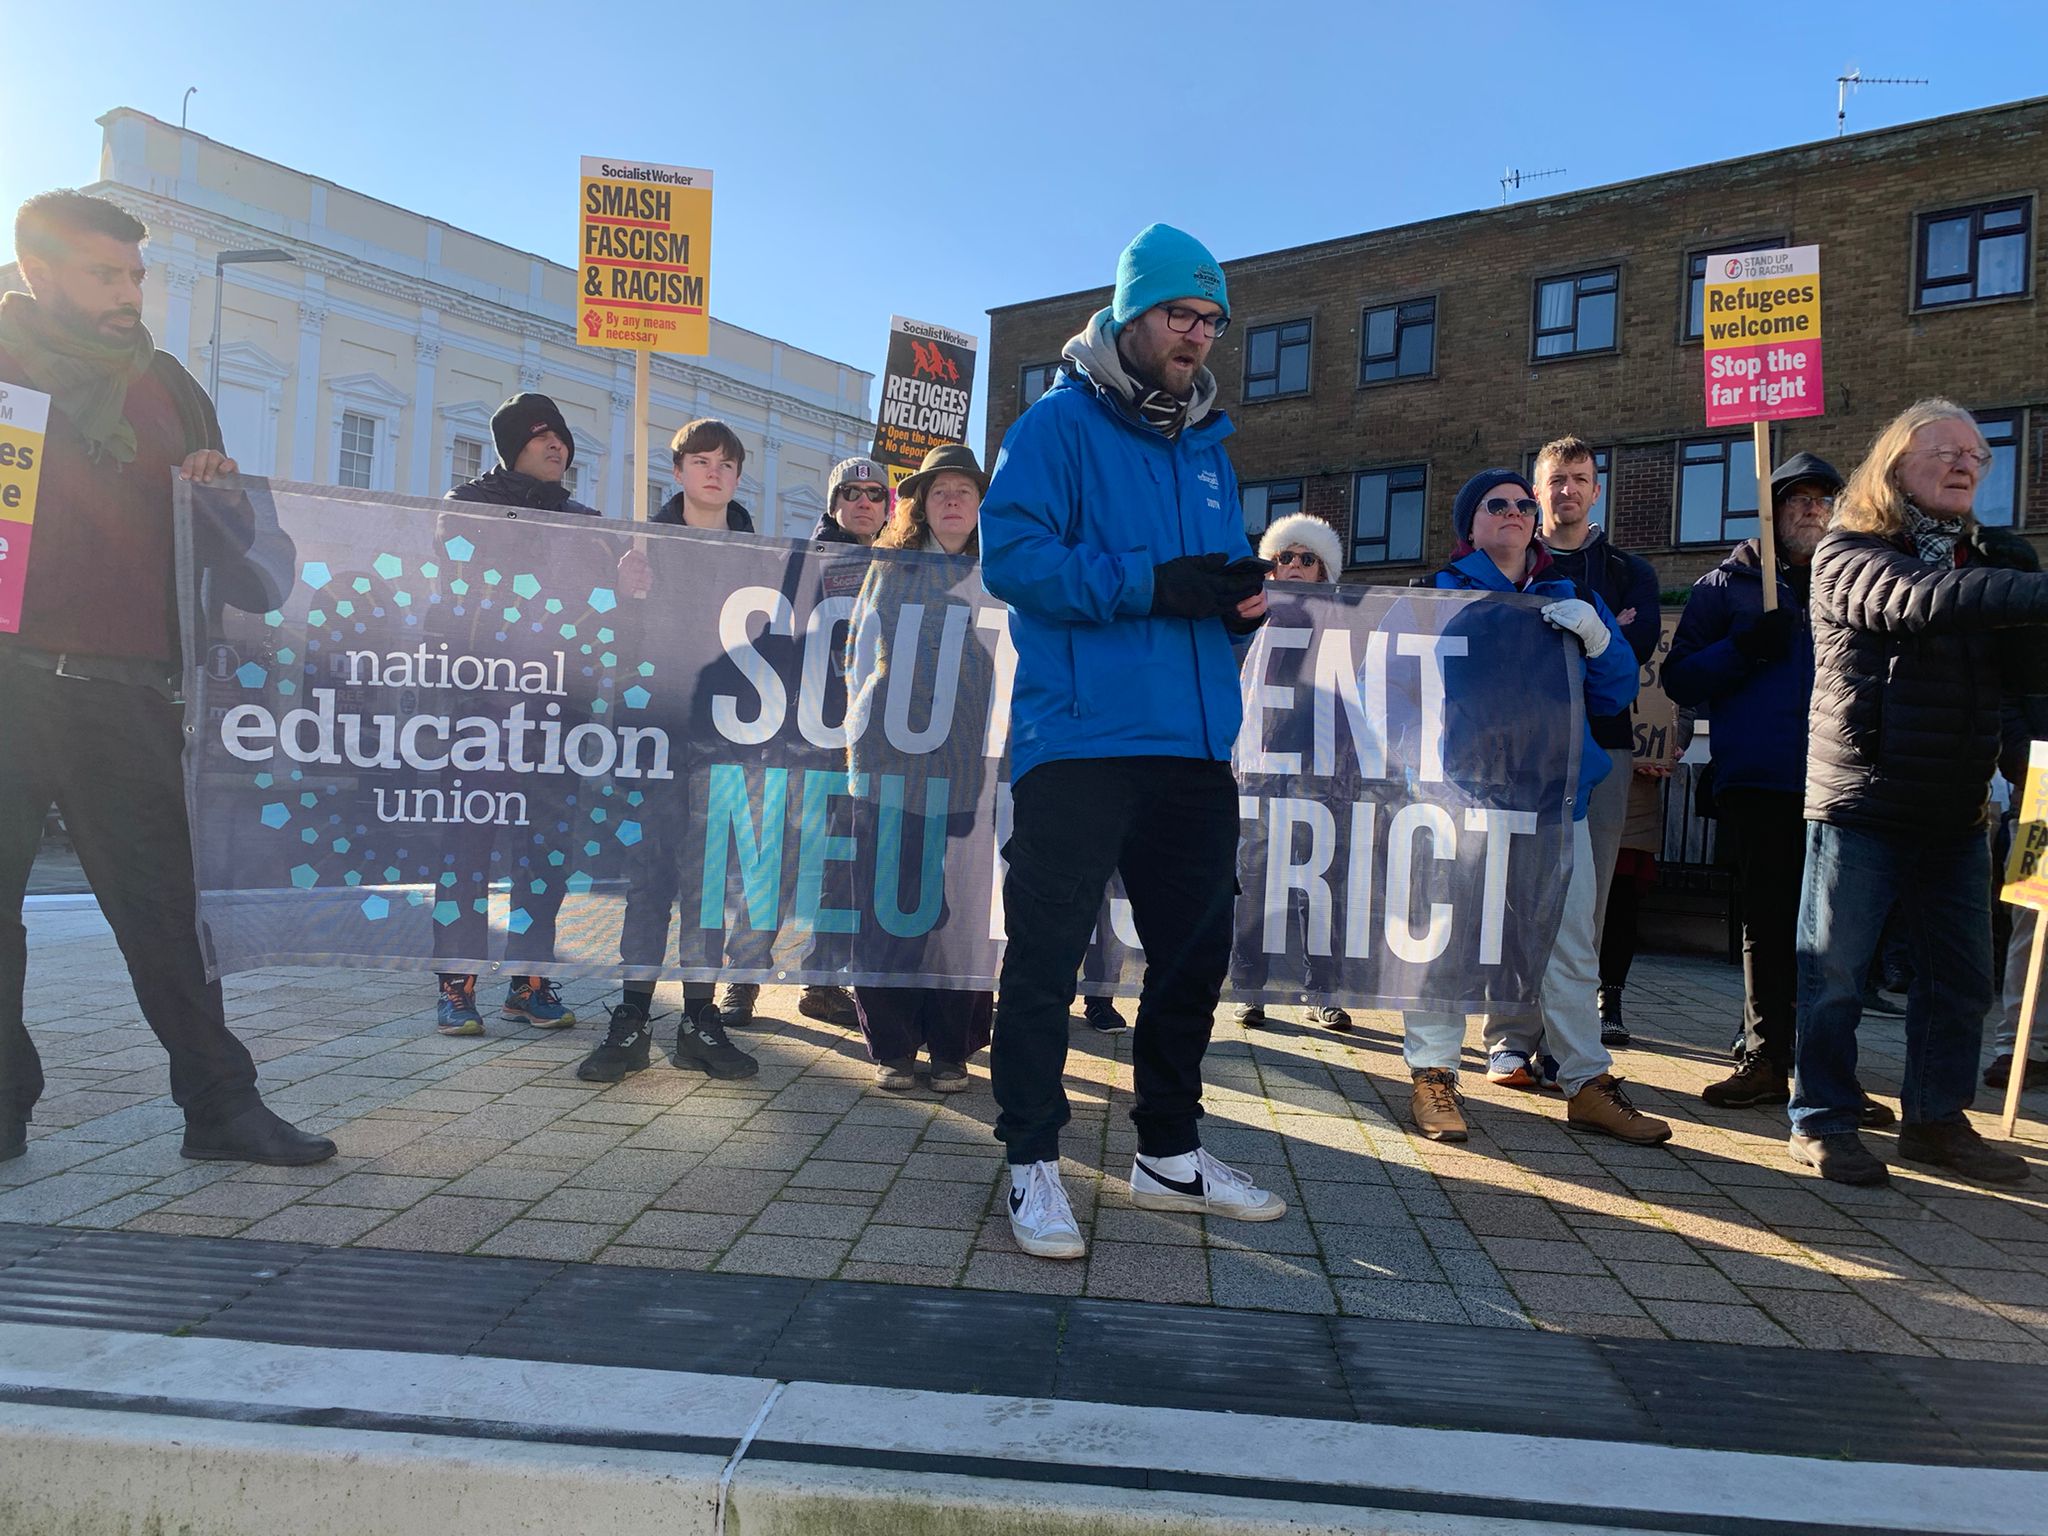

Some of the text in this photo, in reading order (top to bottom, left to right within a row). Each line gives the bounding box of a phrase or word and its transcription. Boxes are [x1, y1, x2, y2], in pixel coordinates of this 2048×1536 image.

[586, 183, 671, 221] SMASH
[585, 224, 690, 265] FASCISM
[1744, 254, 1789, 267] STAND UP
[584, 265, 703, 306] & RACISM
[1745, 263, 1794, 277] TO RACISM
[1709, 285, 1814, 313] Refugees
[606, 311, 677, 330] By any means
[606, 329, 658, 345] necessary
[1710, 314, 1809, 340] welcome
[1710, 348, 1807, 381] Stop the
[886, 374, 969, 415] REFUGEES
[1711, 375, 1807, 406] far right
[883, 399, 965, 439] WELCOME
[887, 425, 909, 440] Open
[912, 430, 926, 444] the
[885, 439, 898, 453] No
[345, 642, 568, 697] national
[711, 586, 1468, 783] SOUT ENT
[220, 688, 674, 780] education
[373, 778, 530, 826] union
[700, 763, 950, 938] NEU
